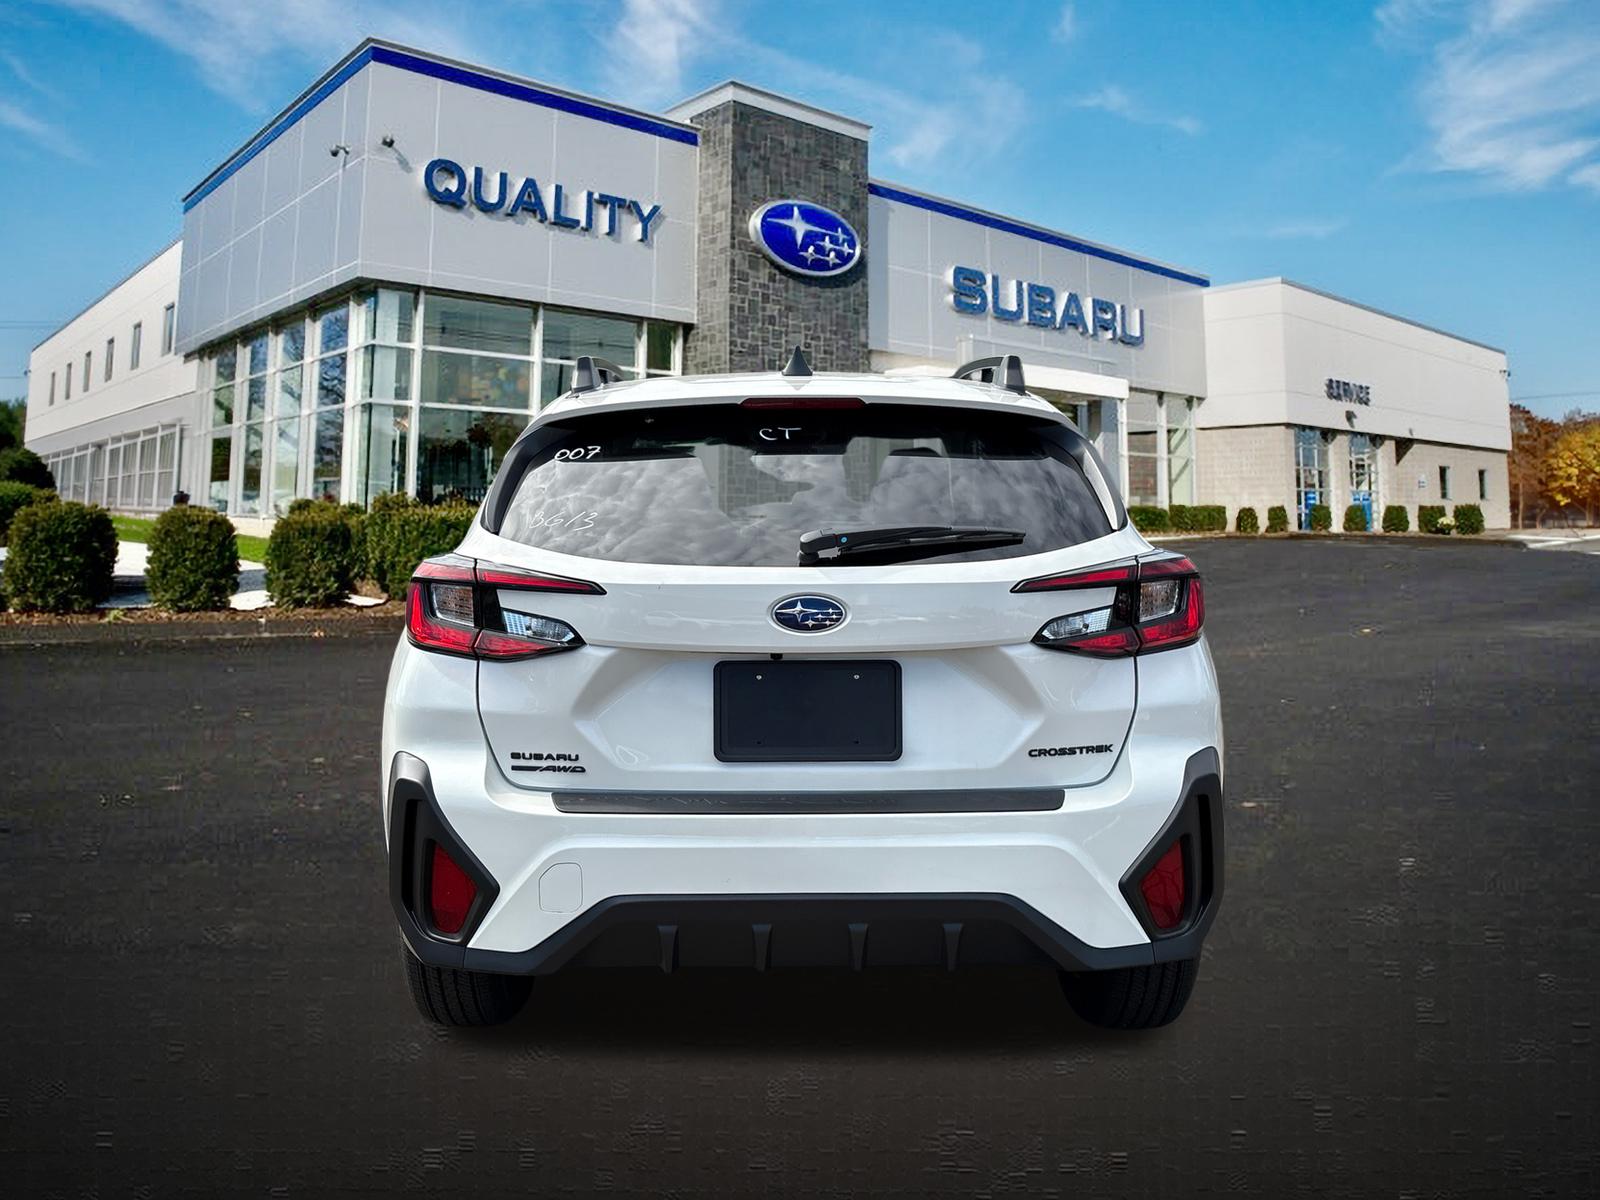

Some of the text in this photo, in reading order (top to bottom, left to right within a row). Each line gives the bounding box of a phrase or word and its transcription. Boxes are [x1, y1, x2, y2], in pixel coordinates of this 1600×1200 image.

[424, 158, 662, 242] QUALITY
[950, 265, 1146, 346] SUBARU
[1325, 377, 1371, 406] SERVICE
[554, 445, 601, 461] 007
[510, 752, 579, 761] SUBARU
[1028, 744, 1113, 758] CROSSTREK
